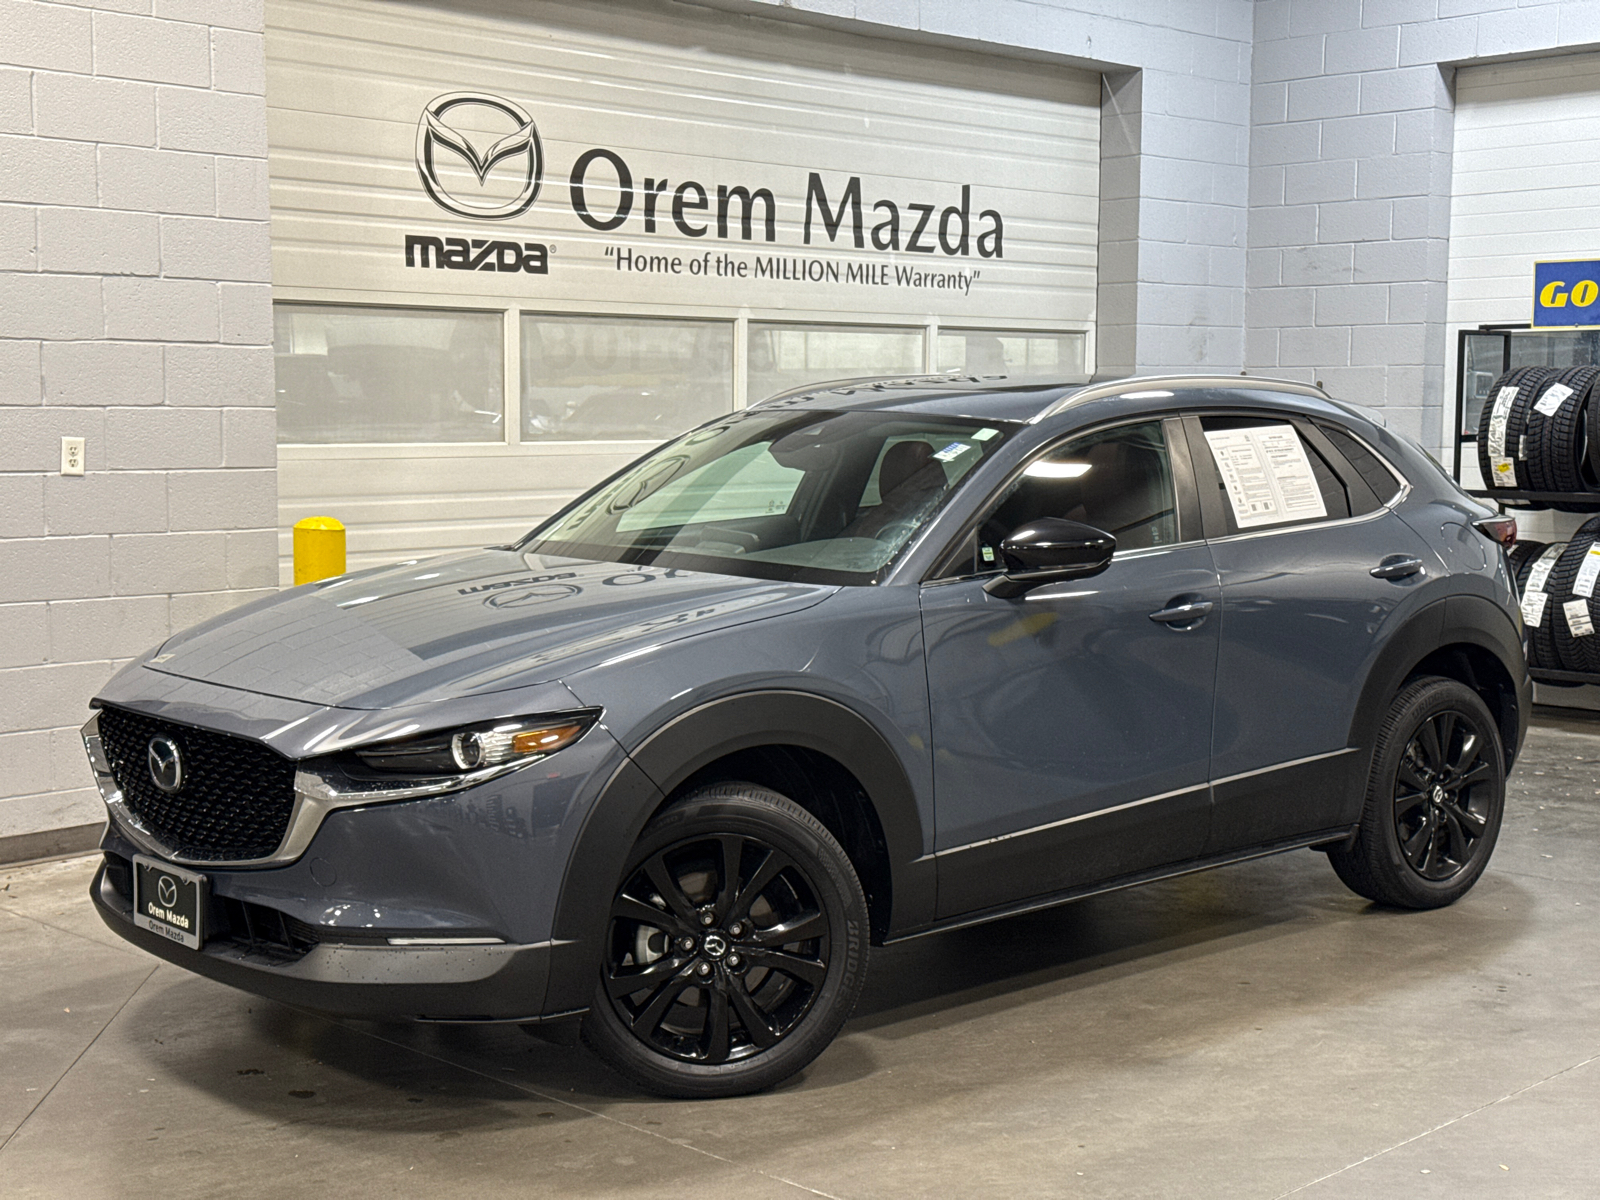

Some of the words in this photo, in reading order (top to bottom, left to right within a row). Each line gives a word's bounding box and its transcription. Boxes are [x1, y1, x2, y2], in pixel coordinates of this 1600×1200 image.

[569, 148, 776, 243] Orem
[803, 172, 1004, 259] Mazda
[689, 252, 711, 276] of
[715, 254, 748, 278] the
[754, 256, 839, 284] MILLION
[845, 262, 889, 285] MILE
[148, 902, 165, 920] Orem
[166, 909, 189, 929] Mazda
[148, 920, 164, 935] Orem
[165, 926, 184, 943] Mazda
